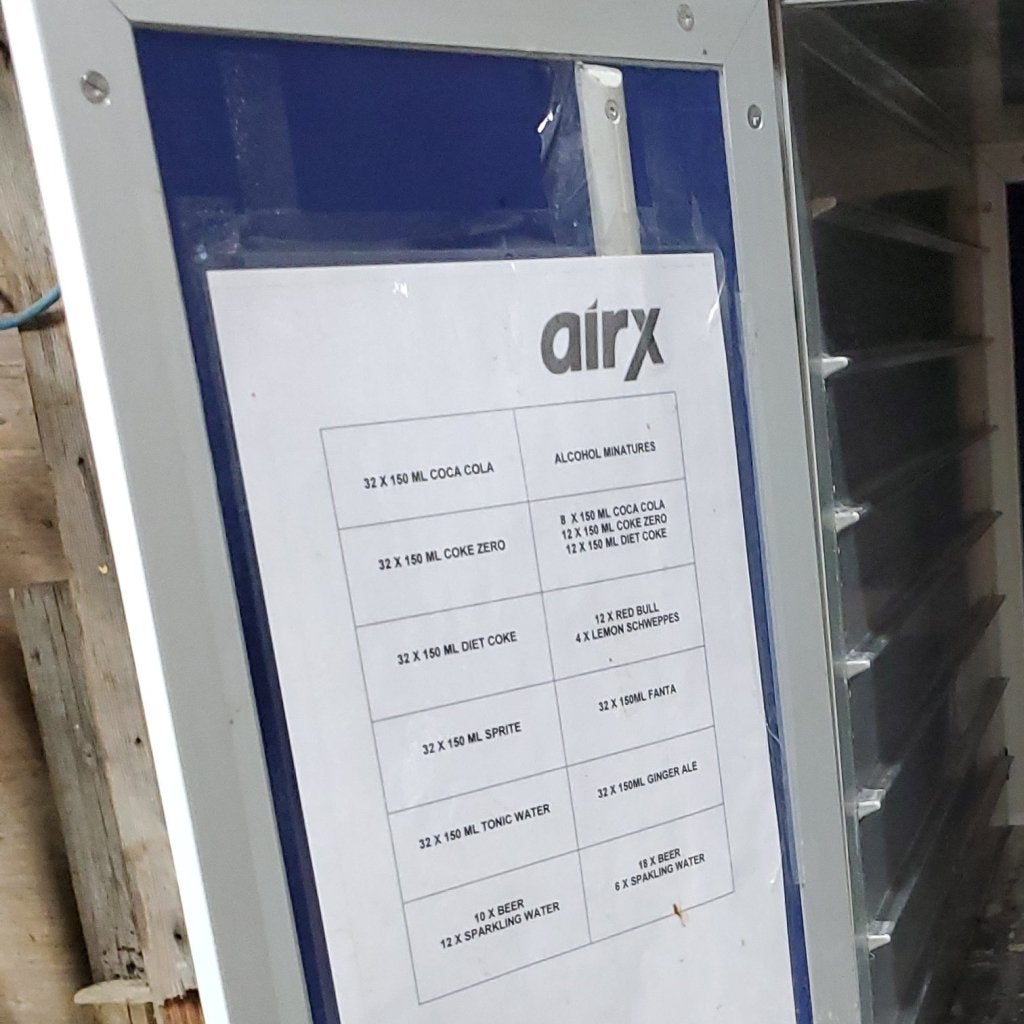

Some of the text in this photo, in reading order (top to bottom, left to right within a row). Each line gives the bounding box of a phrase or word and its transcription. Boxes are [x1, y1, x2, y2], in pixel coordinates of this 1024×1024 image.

[540, 298, 665, 382] airx
[554, 440, 657, 465] ALCOHOL MINATURES
[363, 461, 495, 490] 32 X 150 ML COCA COLA
[561, 512, 668, 540] 12 X 150 ML COKE ZERO
[570, 512, 579, 525] X
[579, 509, 596, 523] 150
[596, 507, 612, 520] ML
[612, 503, 640, 518] COCA
[640, 499, 666, 513] COLA
[377, 539, 506, 571] 32 X 150 ML COKE ZERO
[565, 527, 668, 555] 12 X 150 ML DIET COKE
[575, 611, 680, 644] 4 X LEMON SCHWEPPES
[594, 602, 660, 625] 12 X RED BULL
[396, 630, 518, 666] 32 X 150 ML DIET COKE
[598, 683, 677, 712] 32 X 150ML FANTA
[422, 721, 522, 756] 32 X 150 ML SPRITE
[597, 760, 698, 799] 32 X 150ML GINGER ALE
[418, 803, 551, 850] 32 X 150 ML TONIC WATER
[649, 855, 657, 867] X
[657, 847, 681, 864] BEER
[614, 853, 706, 892] 6 X SPAKLING WATER
[440, 901, 561, 949] 12 X SPARKLING WATER
[474, 898, 525, 924] 10 X BEER
